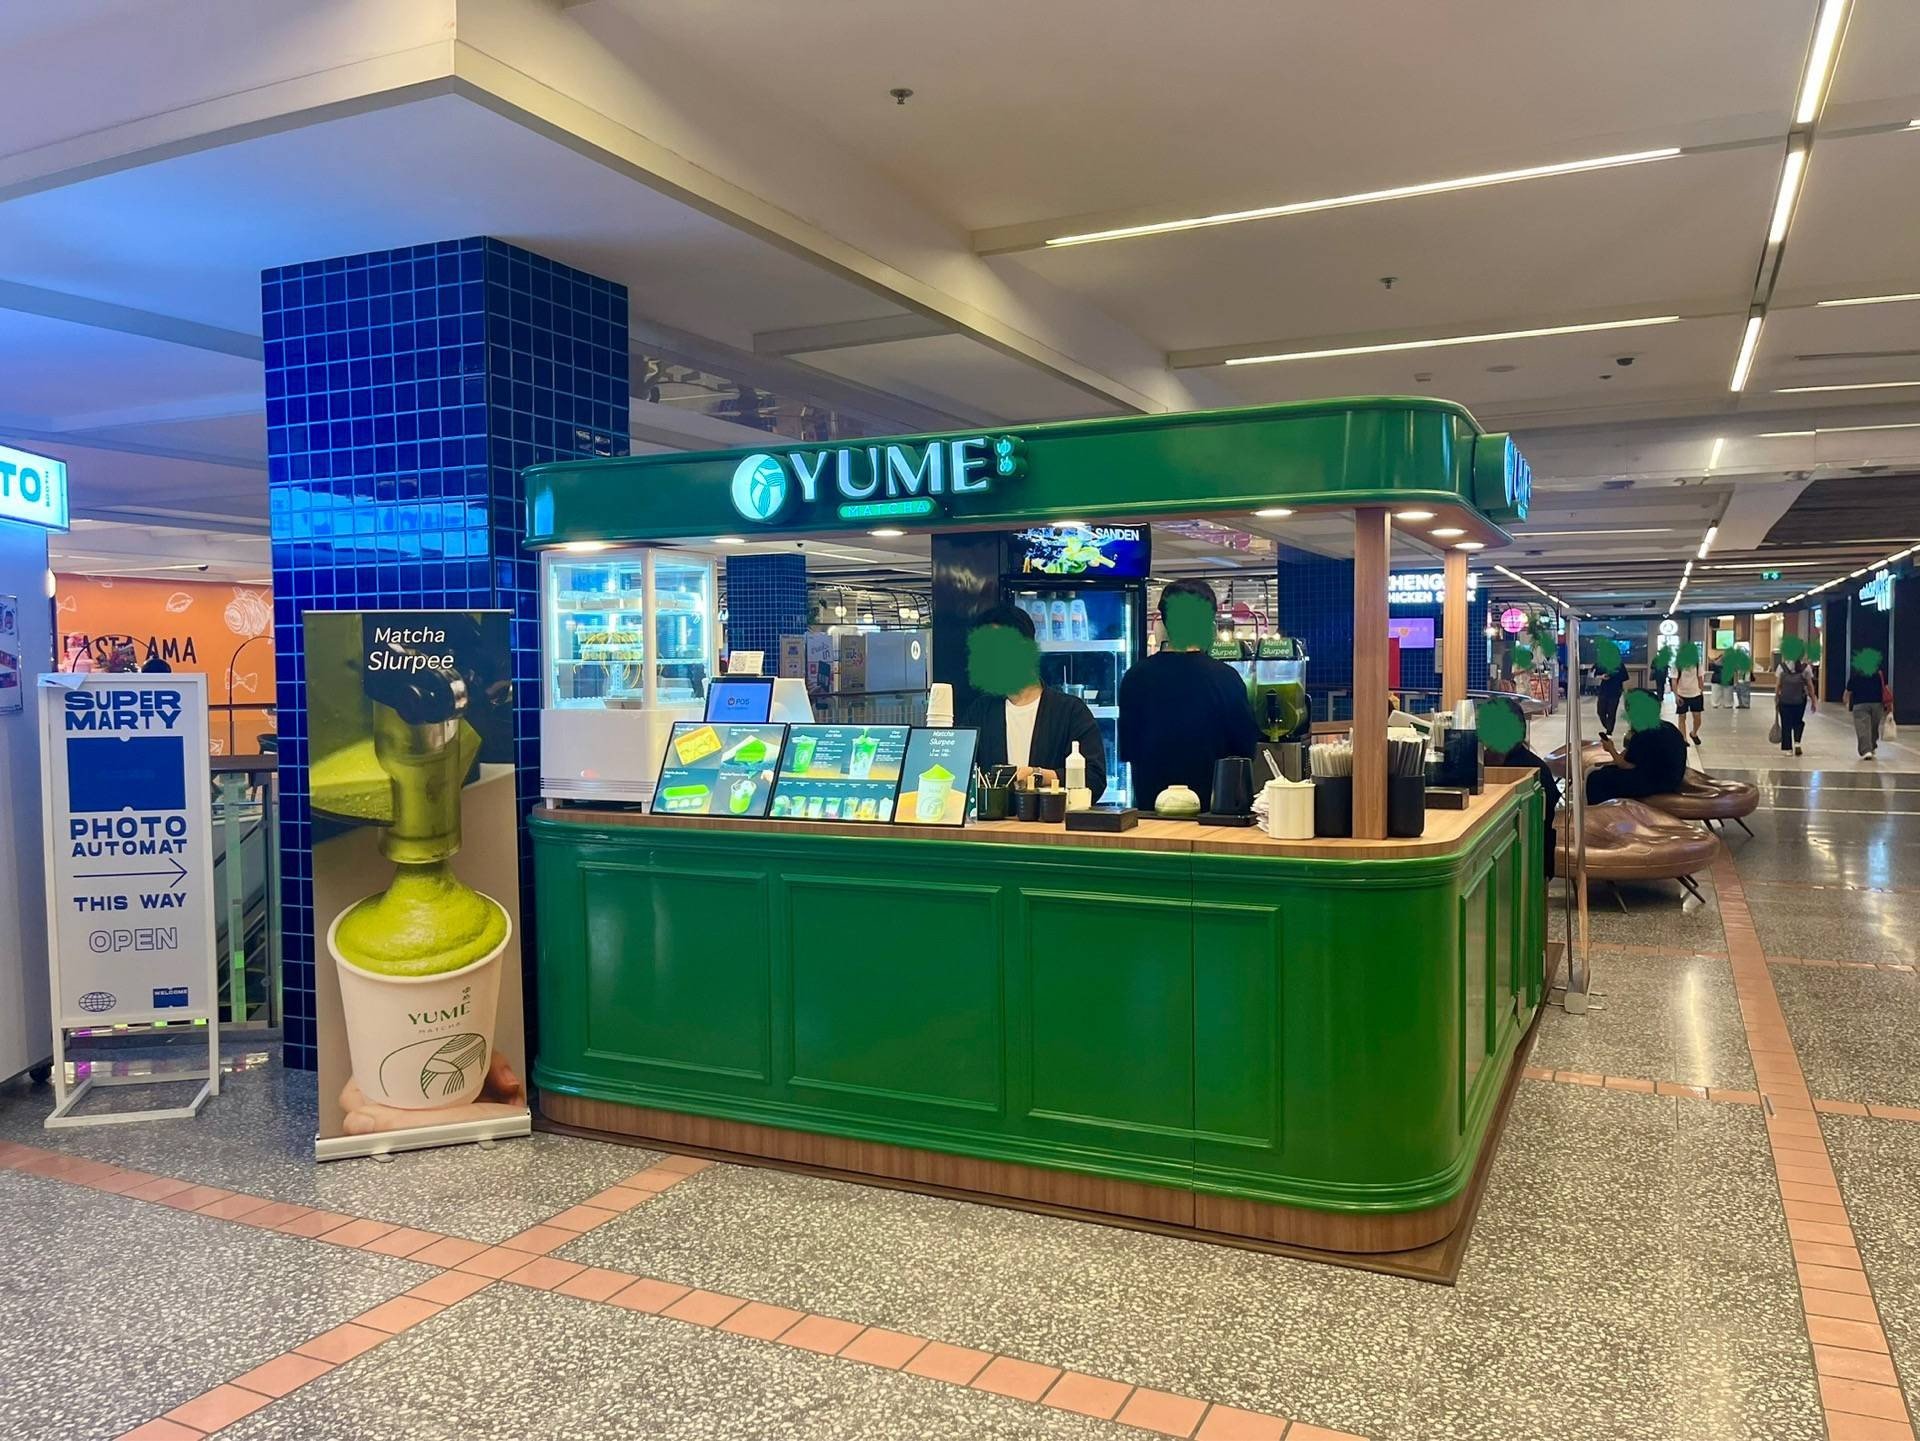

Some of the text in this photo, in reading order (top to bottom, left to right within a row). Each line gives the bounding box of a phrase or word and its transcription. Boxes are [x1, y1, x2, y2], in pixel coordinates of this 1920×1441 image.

[789, 438, 987, 500] YUME
[848, 501, 928, 517] MATCHA
[1095, 527, 1140, 541] SANDEN
[374, 626, 446, 643] Matcha
[145, 636, 197, 664] AMA
[1211, 648, 1238, 656] Slurpee
[1262, 647, 1290, 656] Slurpee
[367, 650, 455, 674] Slurpee
[65, 690, 182, 711] SUPER
[65, 710, 182, 731] MARTY
[70, 816, 187, 840] PHOTO
[72, 839, 187, 858] AUTOMAT
[73, 892, 187, 912] THIS WAY
[89, 927, 178, 953] OPEN
[408, 1001, 471, 1025] YUME
